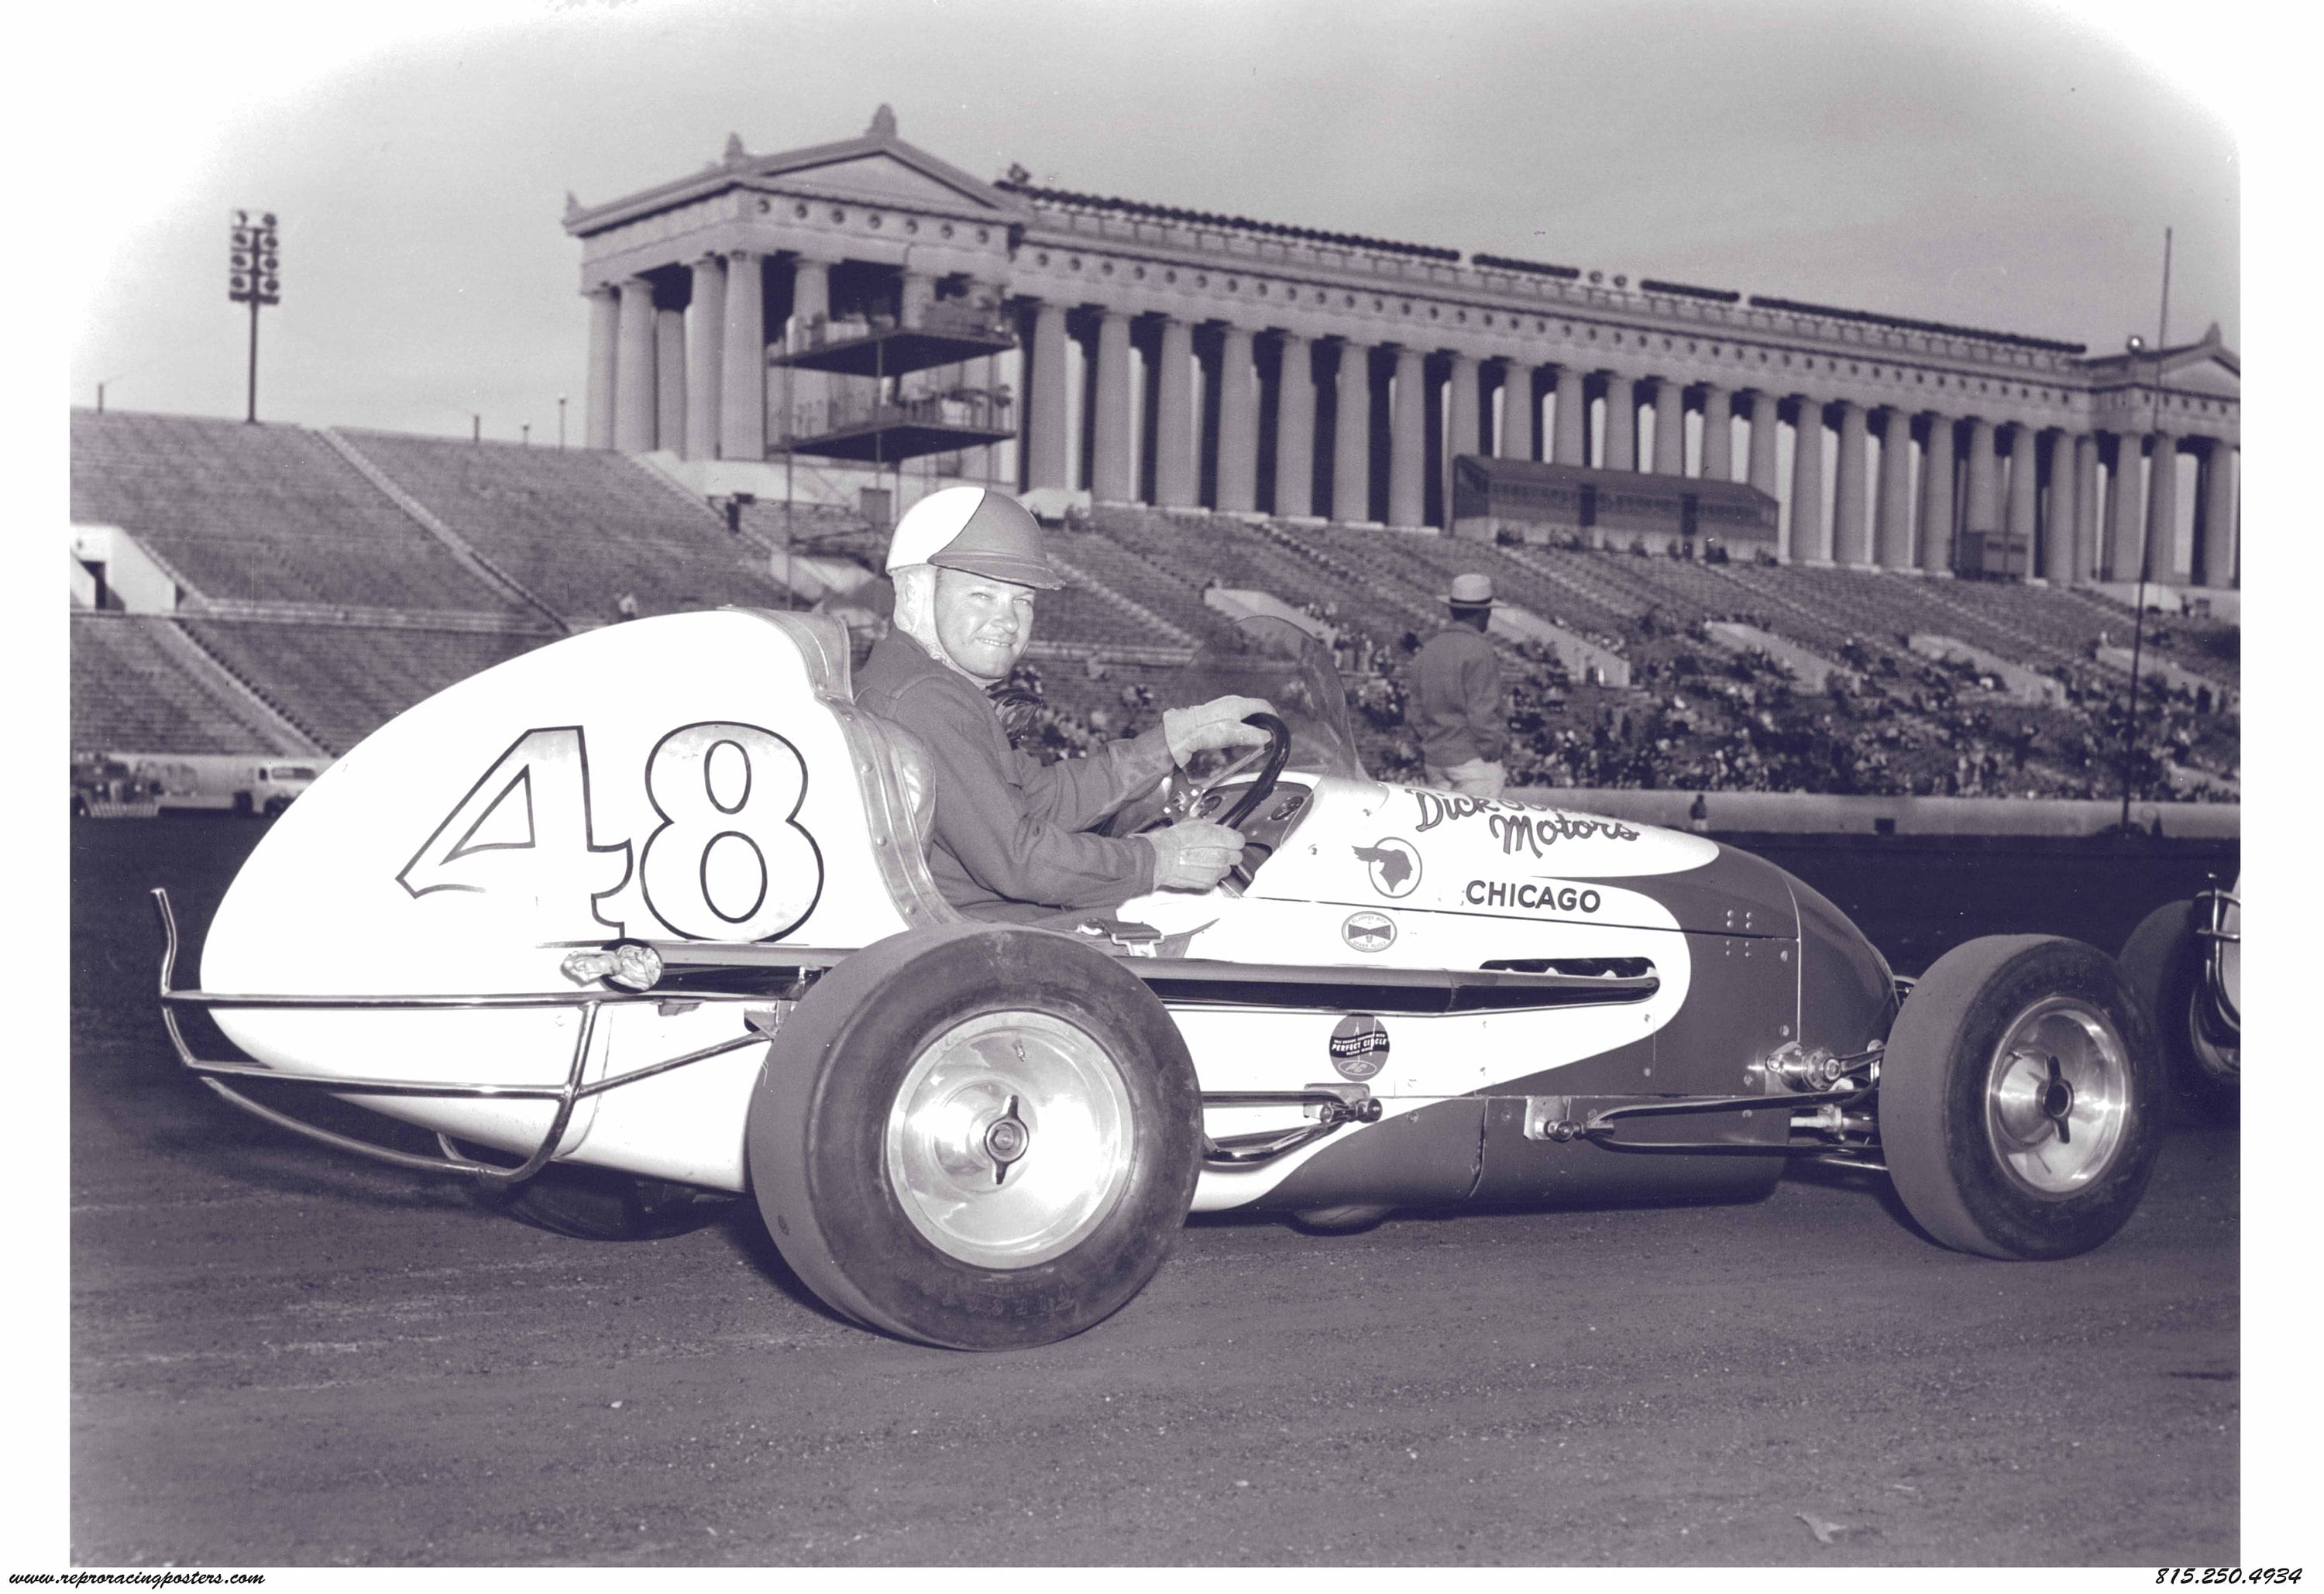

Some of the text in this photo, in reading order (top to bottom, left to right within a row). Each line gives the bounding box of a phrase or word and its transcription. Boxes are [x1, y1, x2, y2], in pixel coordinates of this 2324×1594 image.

[395, 721, 824, 941] 48
[1489, 813, 1641, 859] Motors
[1466, 880, 1601, 913] CHICAGO
[1332, 1038, 1387, 1051] PERFECT CIRCLE
